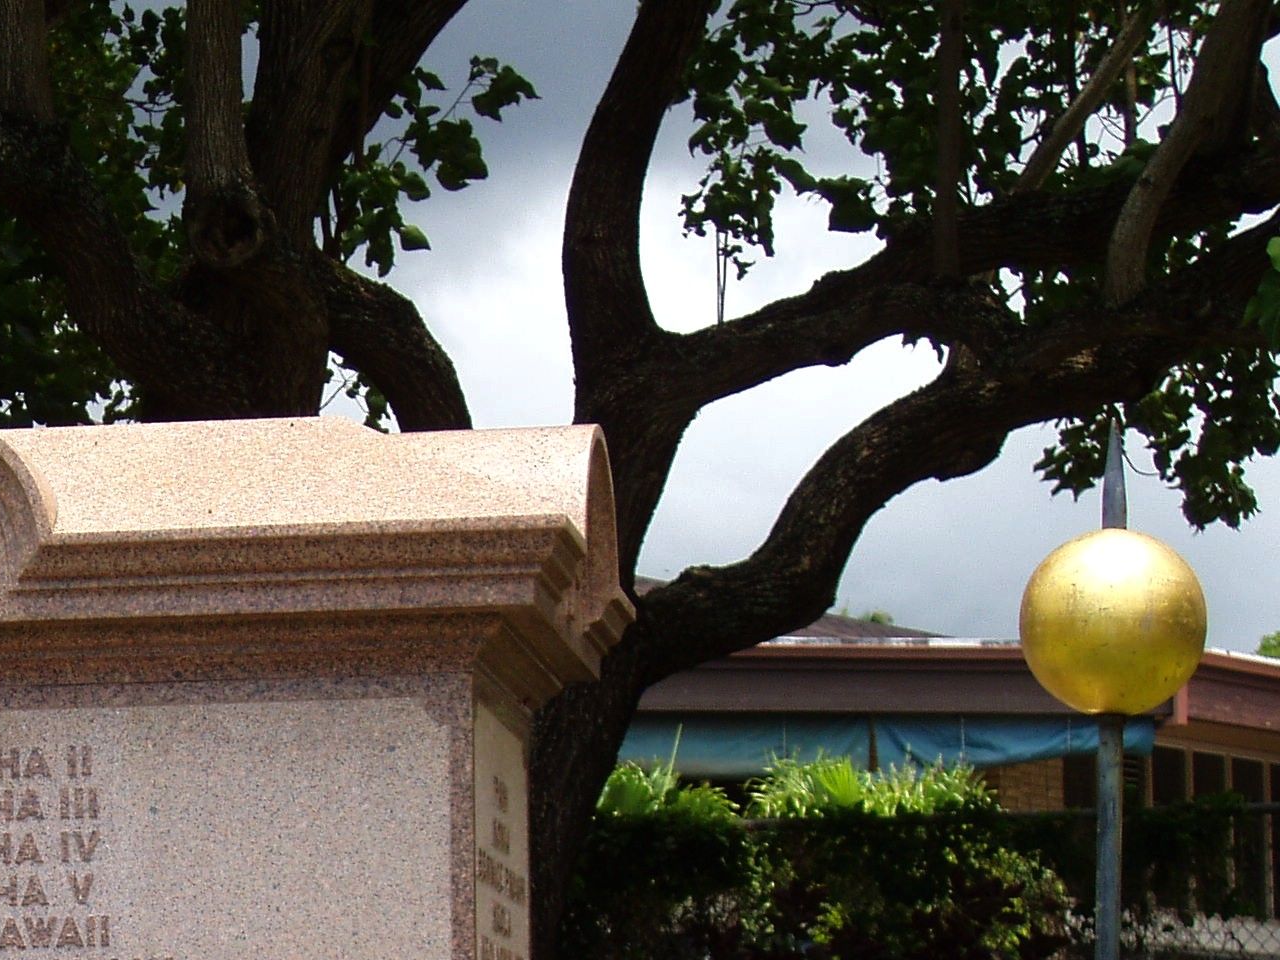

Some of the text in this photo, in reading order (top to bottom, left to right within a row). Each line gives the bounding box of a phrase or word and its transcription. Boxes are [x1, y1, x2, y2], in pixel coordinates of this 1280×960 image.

[67, 745, 92, 777] II
[60, 786, 98, 820] III
[61, 830, 100, 863] IV
[70, 872, 93, 905] V
